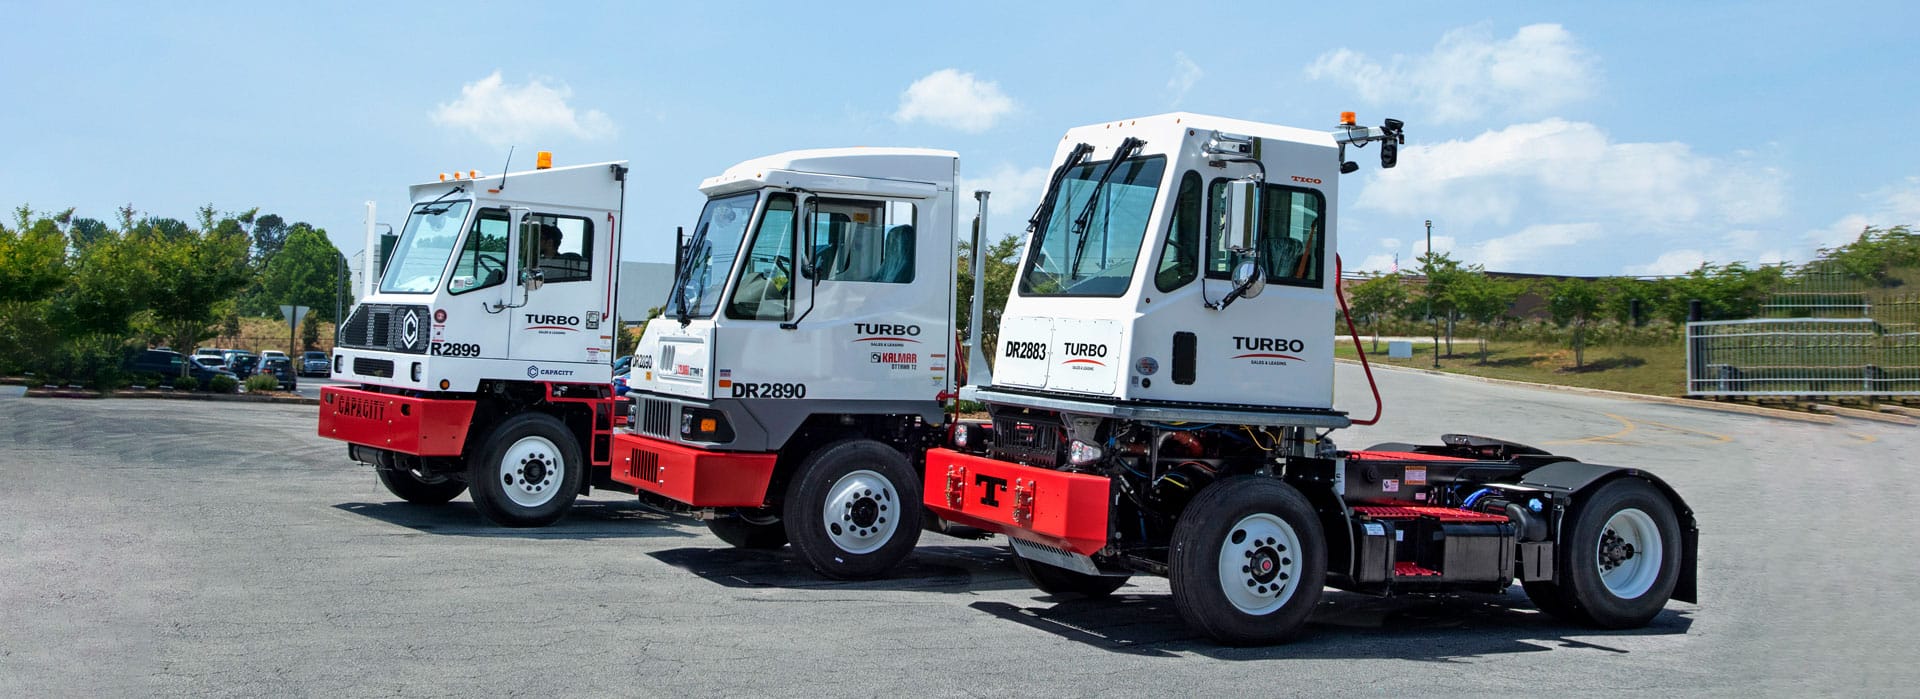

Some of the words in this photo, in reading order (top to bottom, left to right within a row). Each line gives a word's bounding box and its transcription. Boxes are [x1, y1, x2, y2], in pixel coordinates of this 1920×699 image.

[1291, 175, 1322, 184] TICO
[525, 313, 580, 326] TURBO
[854, 322, 921, 337] TURBO
[431, 342, 480, 357] R2899
[1005, 341, 1047, 361] DR2883
[1064, 342, 1108, 358] TURBO
[1232, 336, 1305, 353] TURBO
[882, 352, 917, 364] KALMAR
[732, 383, 806, 399] DR2890
[338, 395, 385, 420] CAPACITY
[975, 474, 1008, 507] T
